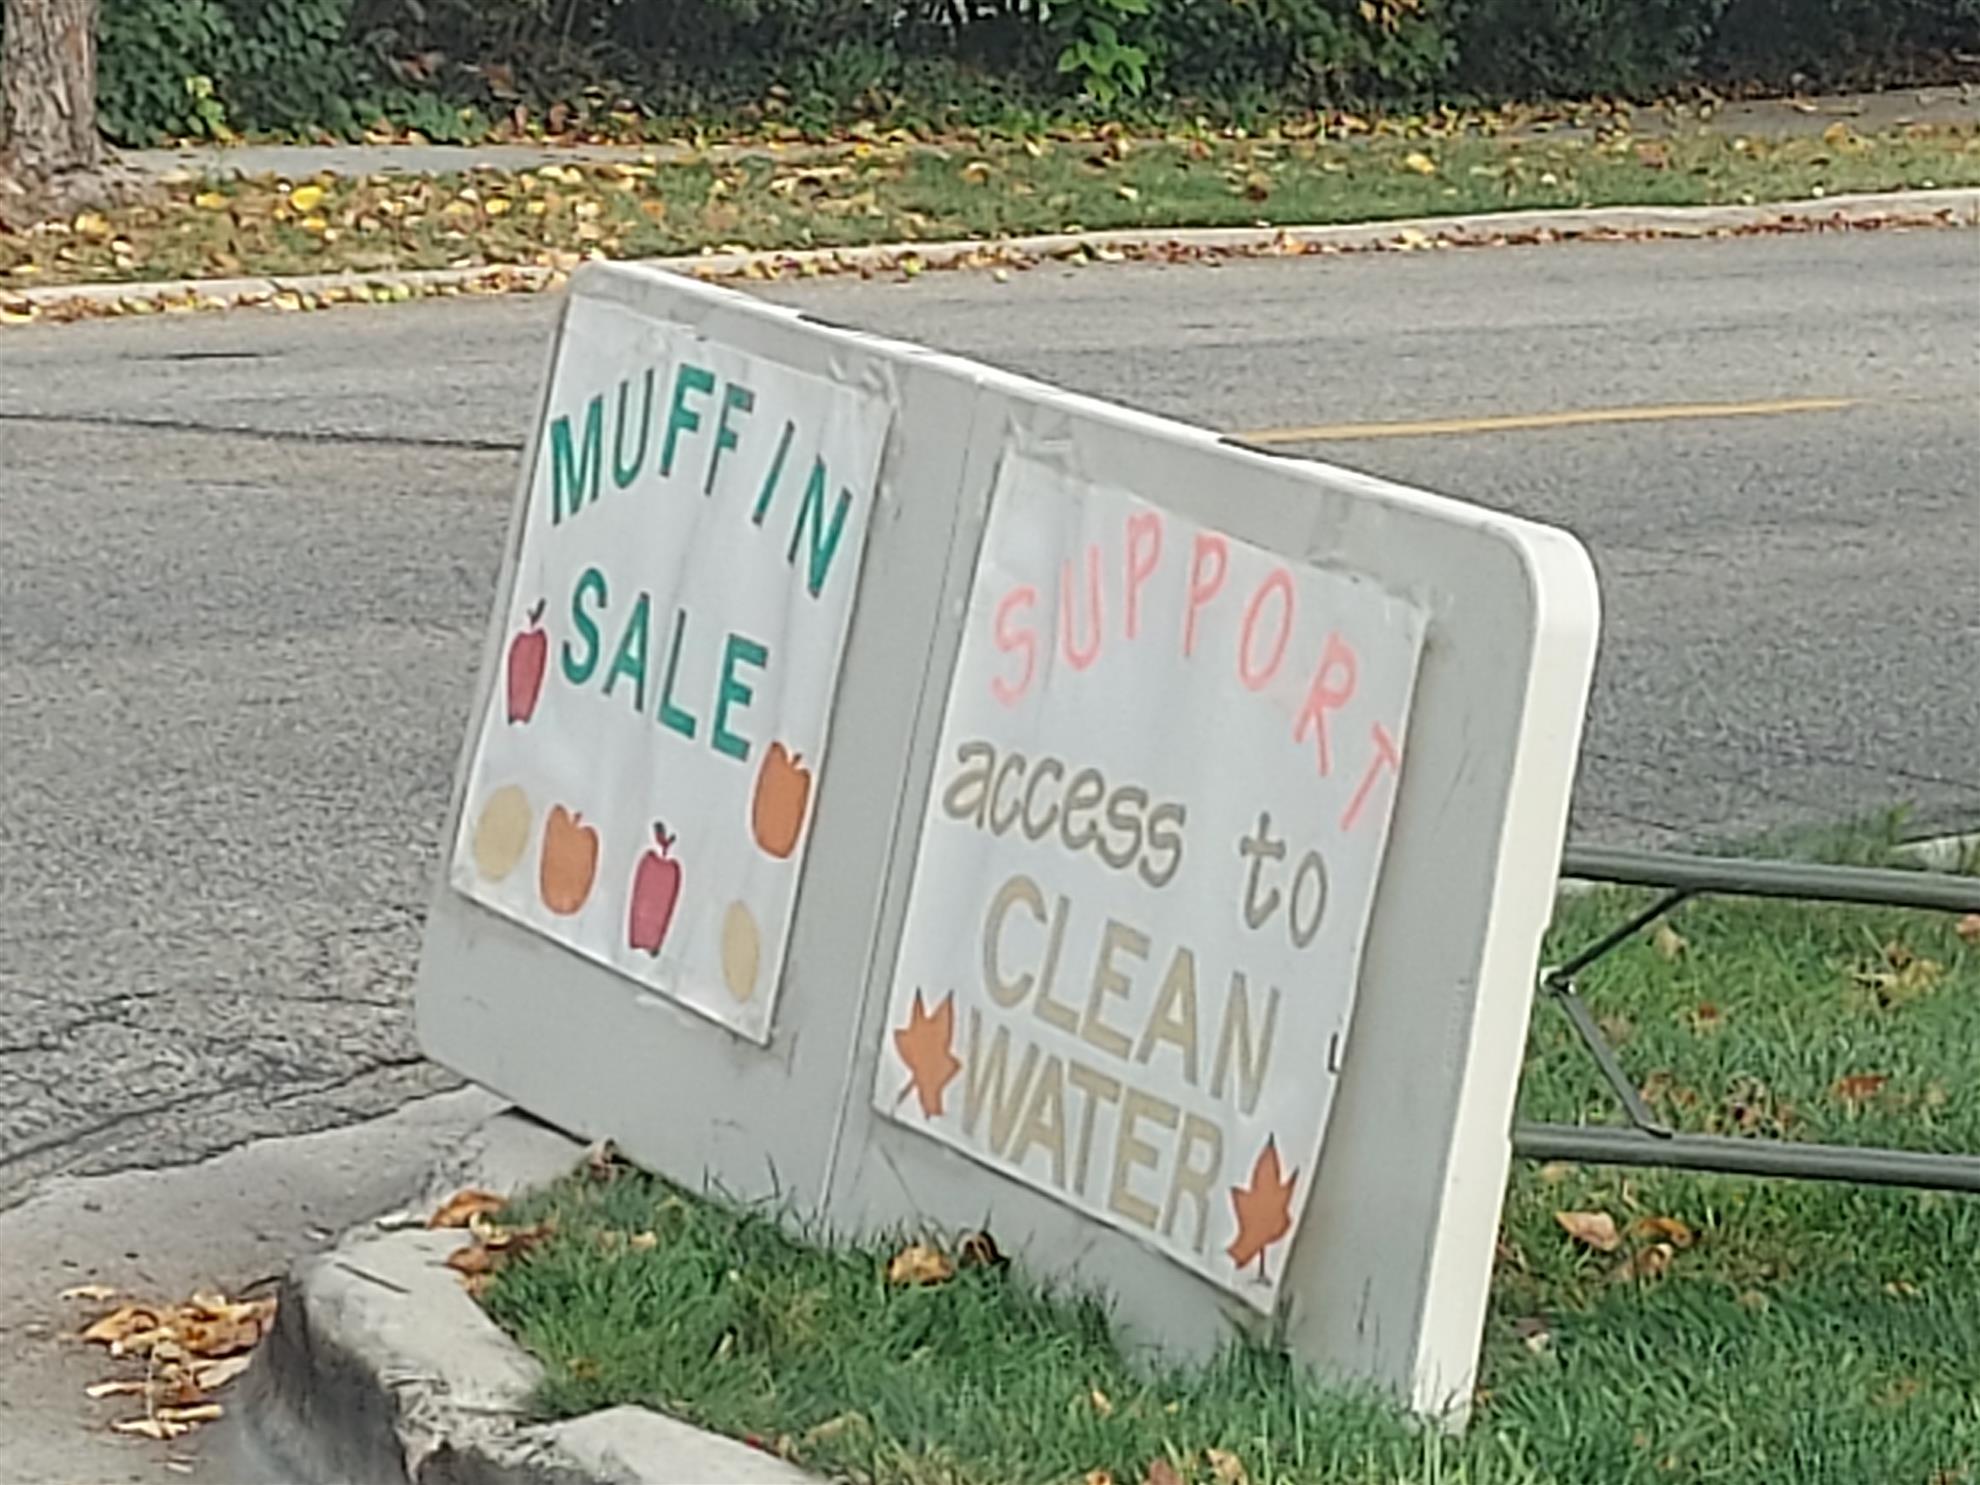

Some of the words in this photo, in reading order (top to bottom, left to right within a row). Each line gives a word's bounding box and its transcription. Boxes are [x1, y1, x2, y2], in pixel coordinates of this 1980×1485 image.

[549, 362, 853, 600] MUFFIN
[561, 567, 769, 762] SALE
[991, 511, 1400, 832] SUPPORT
[943, 741, 1187, 888] access
[1239, 811, 1329, 949] to
[983, 875, 1281, 1116] CLEAN
[961, 1005, 1223, 1255] WATER
